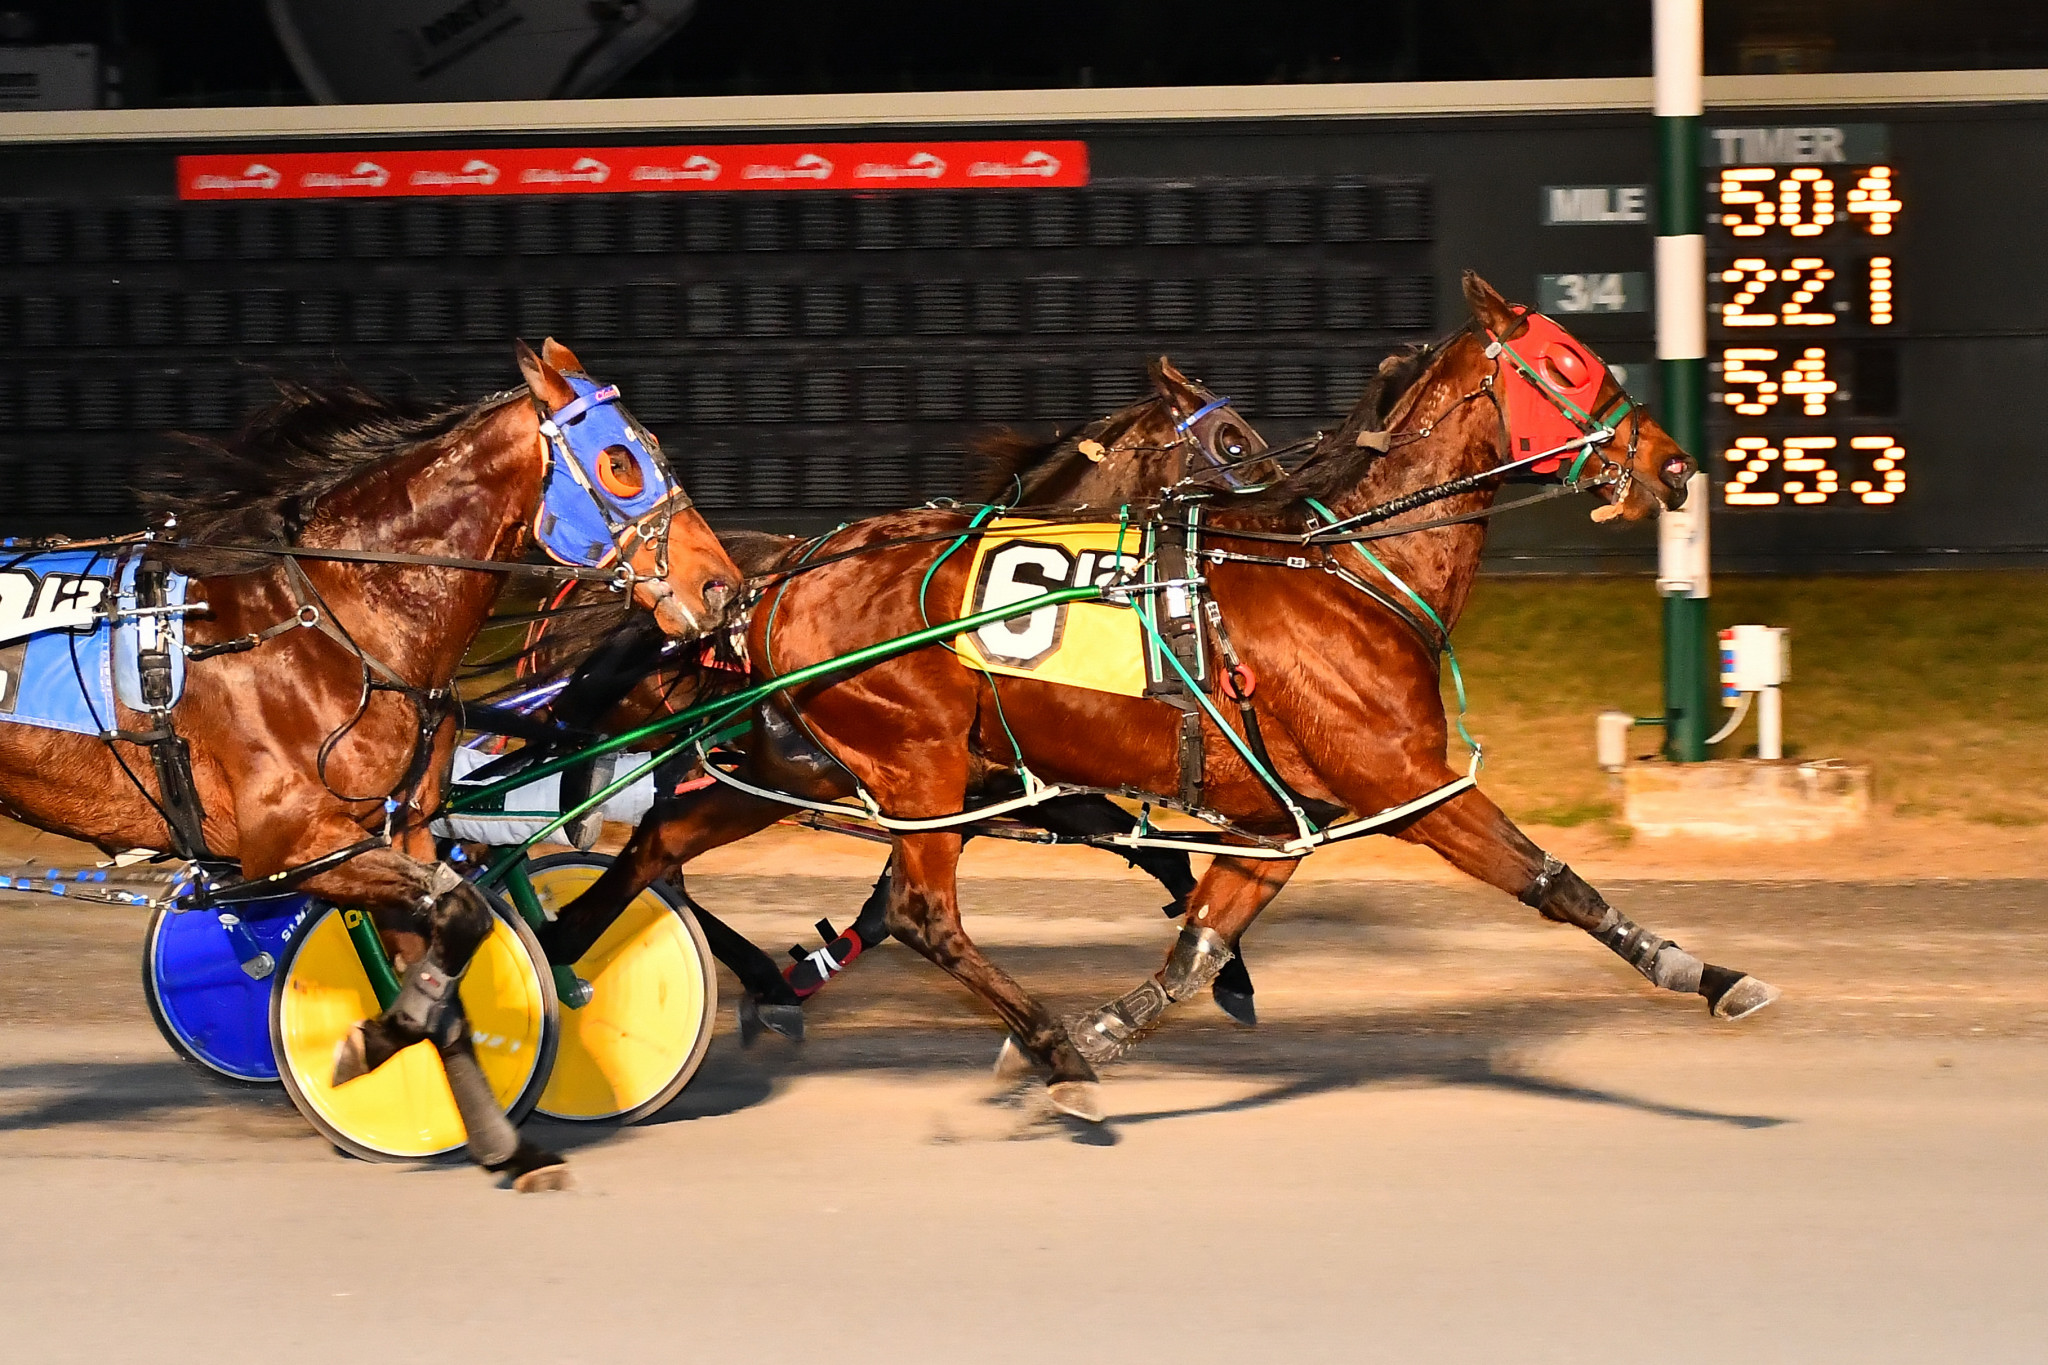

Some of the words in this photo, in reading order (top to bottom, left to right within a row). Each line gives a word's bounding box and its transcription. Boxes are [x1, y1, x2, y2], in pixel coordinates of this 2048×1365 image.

[1711, 127, 1847, 163] TIMER
[1550, 187, 1648, 222] MILE
[976, 544, 1071, 661] 6
